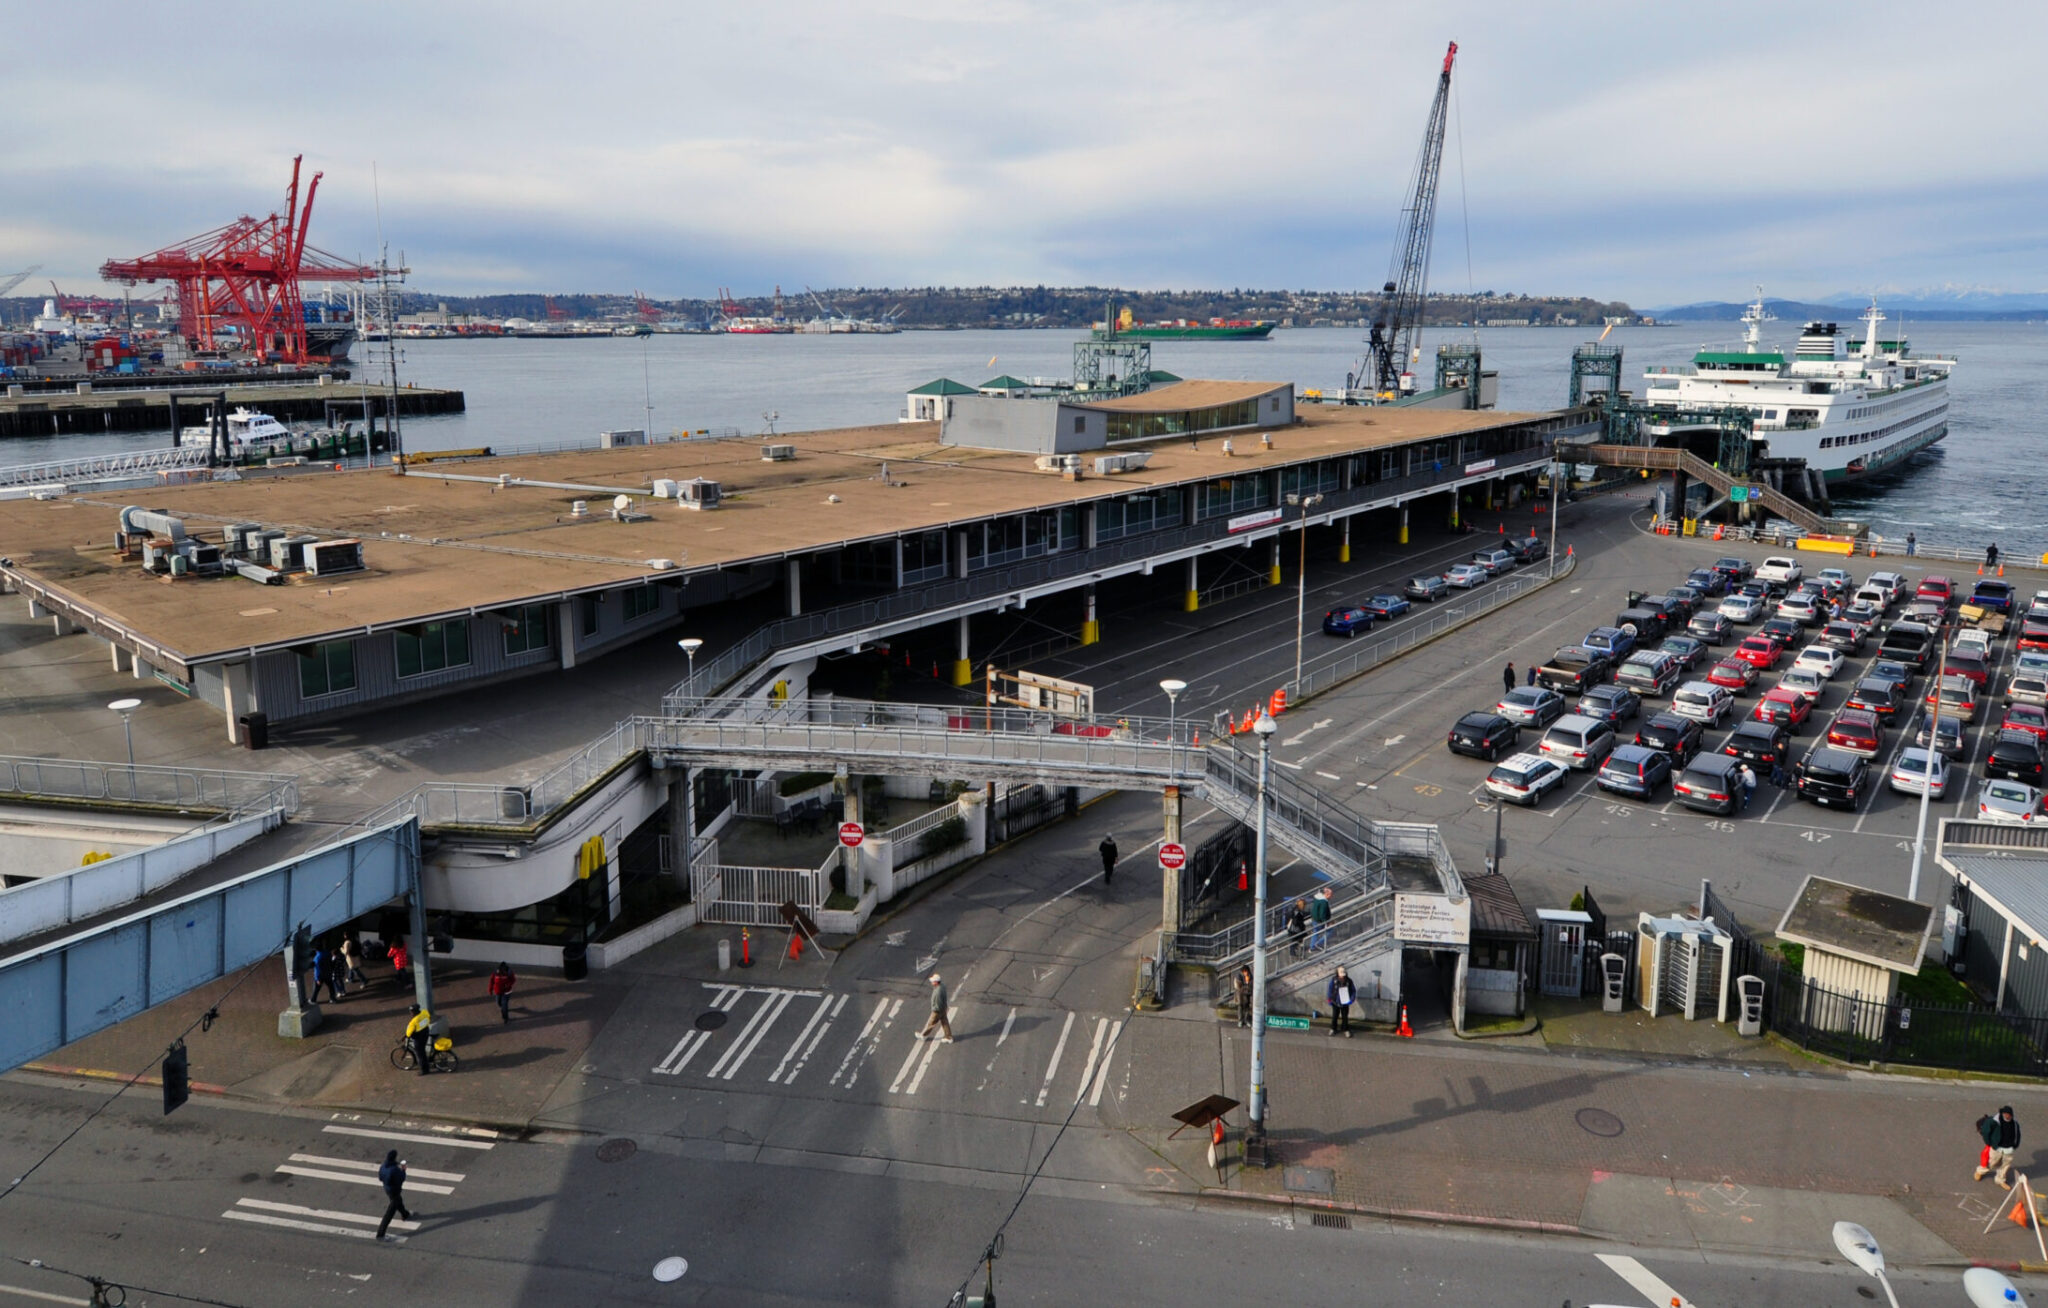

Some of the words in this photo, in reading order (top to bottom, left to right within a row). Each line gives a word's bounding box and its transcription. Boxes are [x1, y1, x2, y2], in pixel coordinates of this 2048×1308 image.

[1413, 784, 1442, 797] 43
[1604, 804, 1634, 818] 45
[1704, 820, 1736, 833] 46
[1800, 831, 1832, 843] 47
[1267, 1016, 1297, 1027] Alaskan
